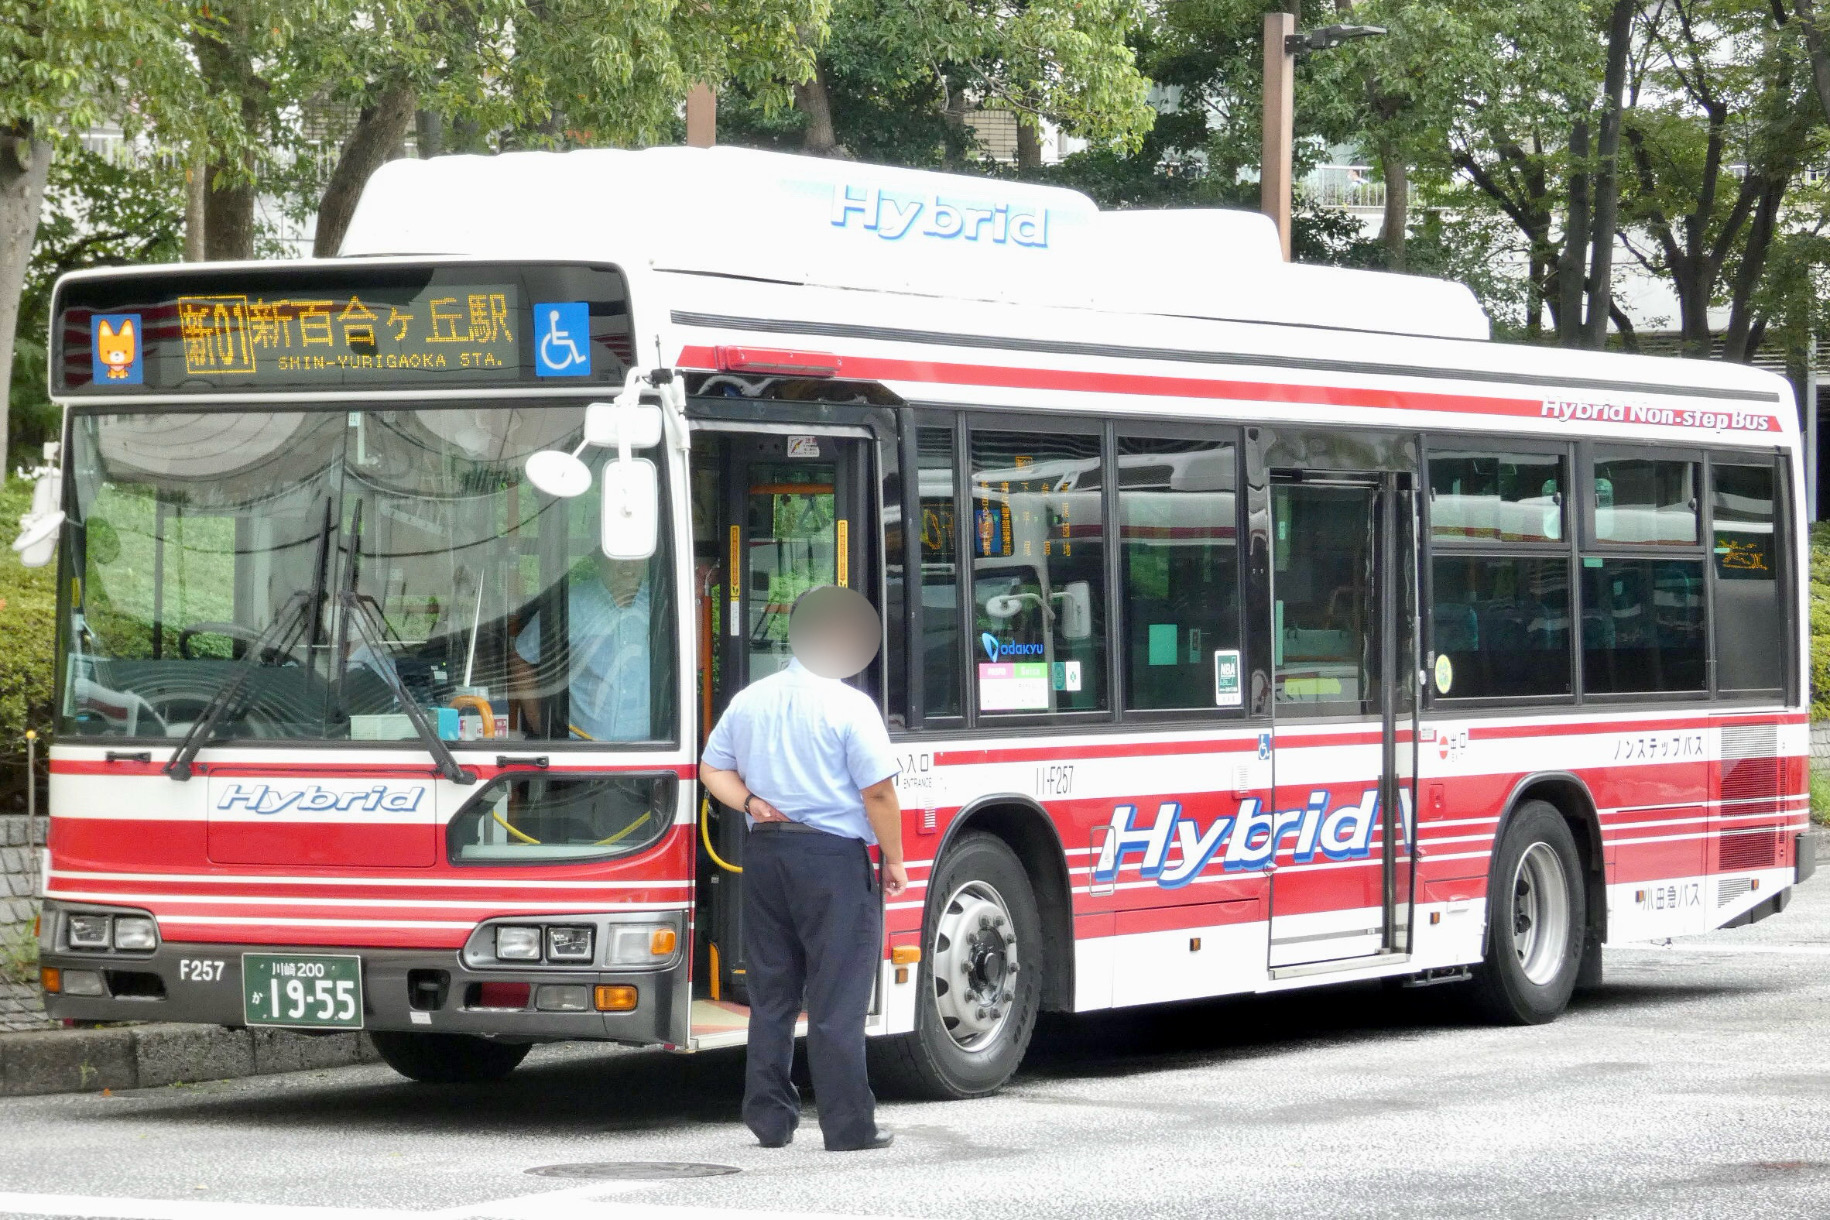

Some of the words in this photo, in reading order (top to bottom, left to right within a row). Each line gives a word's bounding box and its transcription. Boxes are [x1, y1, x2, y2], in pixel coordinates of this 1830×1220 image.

[831, 183, 1049, 248] Hybrid
[277, 353, 447, 372] SHIN-YURIGAOKA
[459, 352, 503, 368] STA.
[1540, 396, 1625, 422] Hybrid
[1630, 401, 1729, 433] Non-step
[1731, 409, 1769, 430] Bus
[1000, 640, 1044, 655] odakyu
[1614, 735, 1703, 760] ノンステップバス
[907, 753, 929, 774] 入口
[217, 784, 425, 815] Hybrid
[1094, 788, 1380, 890] Hybrid
[1642, 883, 1700, 911] 小田急バス
[180, 959, 225, 981] F257
[270, 978, 355, 1020] 19-55
